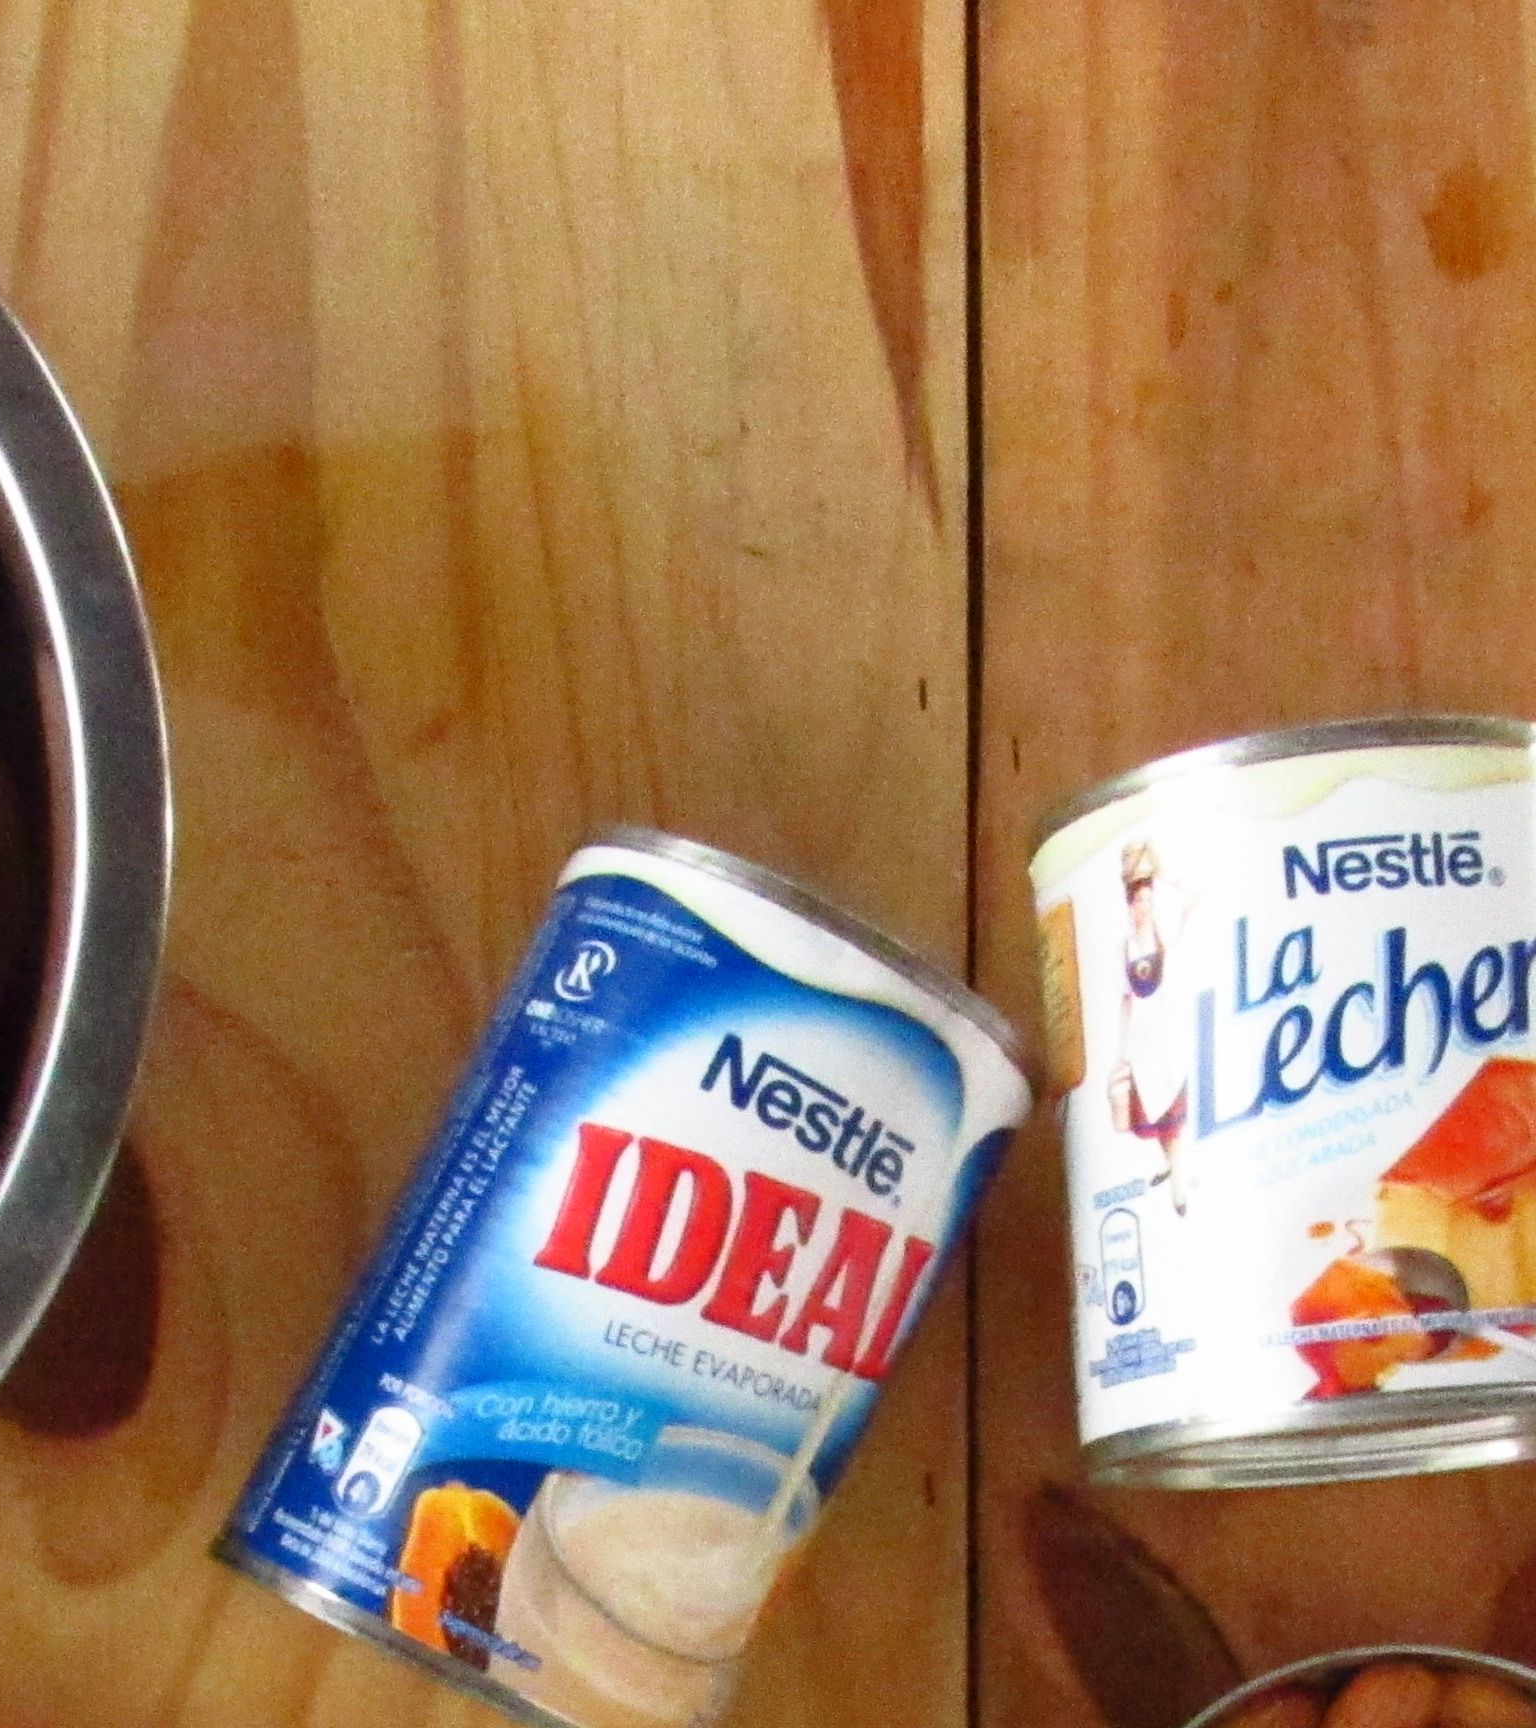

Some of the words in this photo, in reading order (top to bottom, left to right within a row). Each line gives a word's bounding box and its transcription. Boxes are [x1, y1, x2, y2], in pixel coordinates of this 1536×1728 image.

[1234, 916, 1322, 1015] La
[370, 1320, 390, 1345] LA
[386, 1261, 421, 1318] LECHE
[415, 1175, 464, 1260] MATERNA
[460, 1151, 479, 1174] ES
[472, 1130, 491, 1149] EL
[485, 1064, 526, 1125] MEJOR
[393, 1248, 450, 1343] ALIMENTO
[442, 1199, 477, 1246] PARA
[468, 1176, 490, 1196] EL
[482, 1081, 538, 1173] LACTANTE
[542, 1392, 619, 1422] hierro
[623, 1408, 644, 1431] y
[604, 1320, 687, 1367] LECHE
[692, 1350, 821, 1412] EVAPORADA
